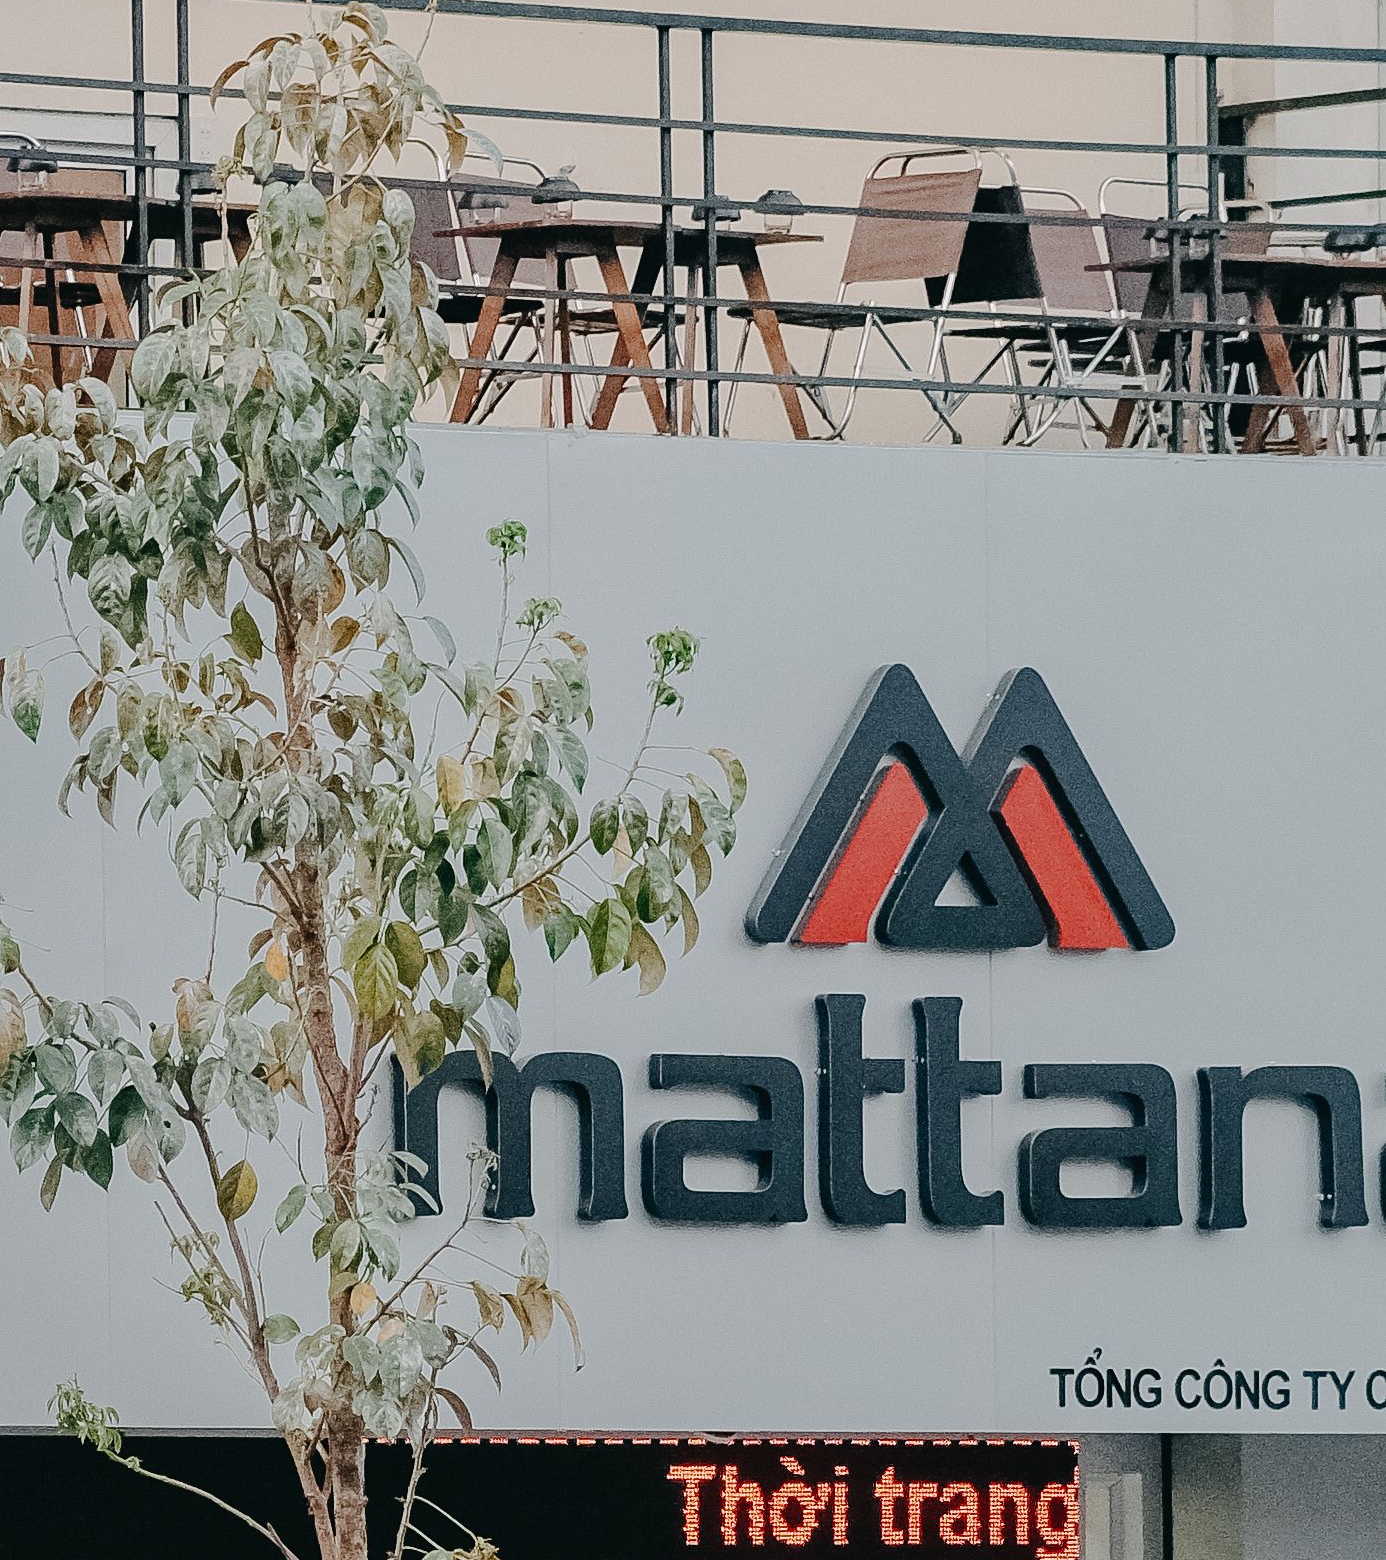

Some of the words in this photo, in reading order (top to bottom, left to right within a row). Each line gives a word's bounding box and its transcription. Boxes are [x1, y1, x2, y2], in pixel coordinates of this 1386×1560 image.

[1049, 1347, 1163, 1410] TỔNG
[1174, 1359, 1292, 1410] CÔNG
[1303, 1370, 1354, 1410] TY
[666, 1455, 851, 1546] Thời
